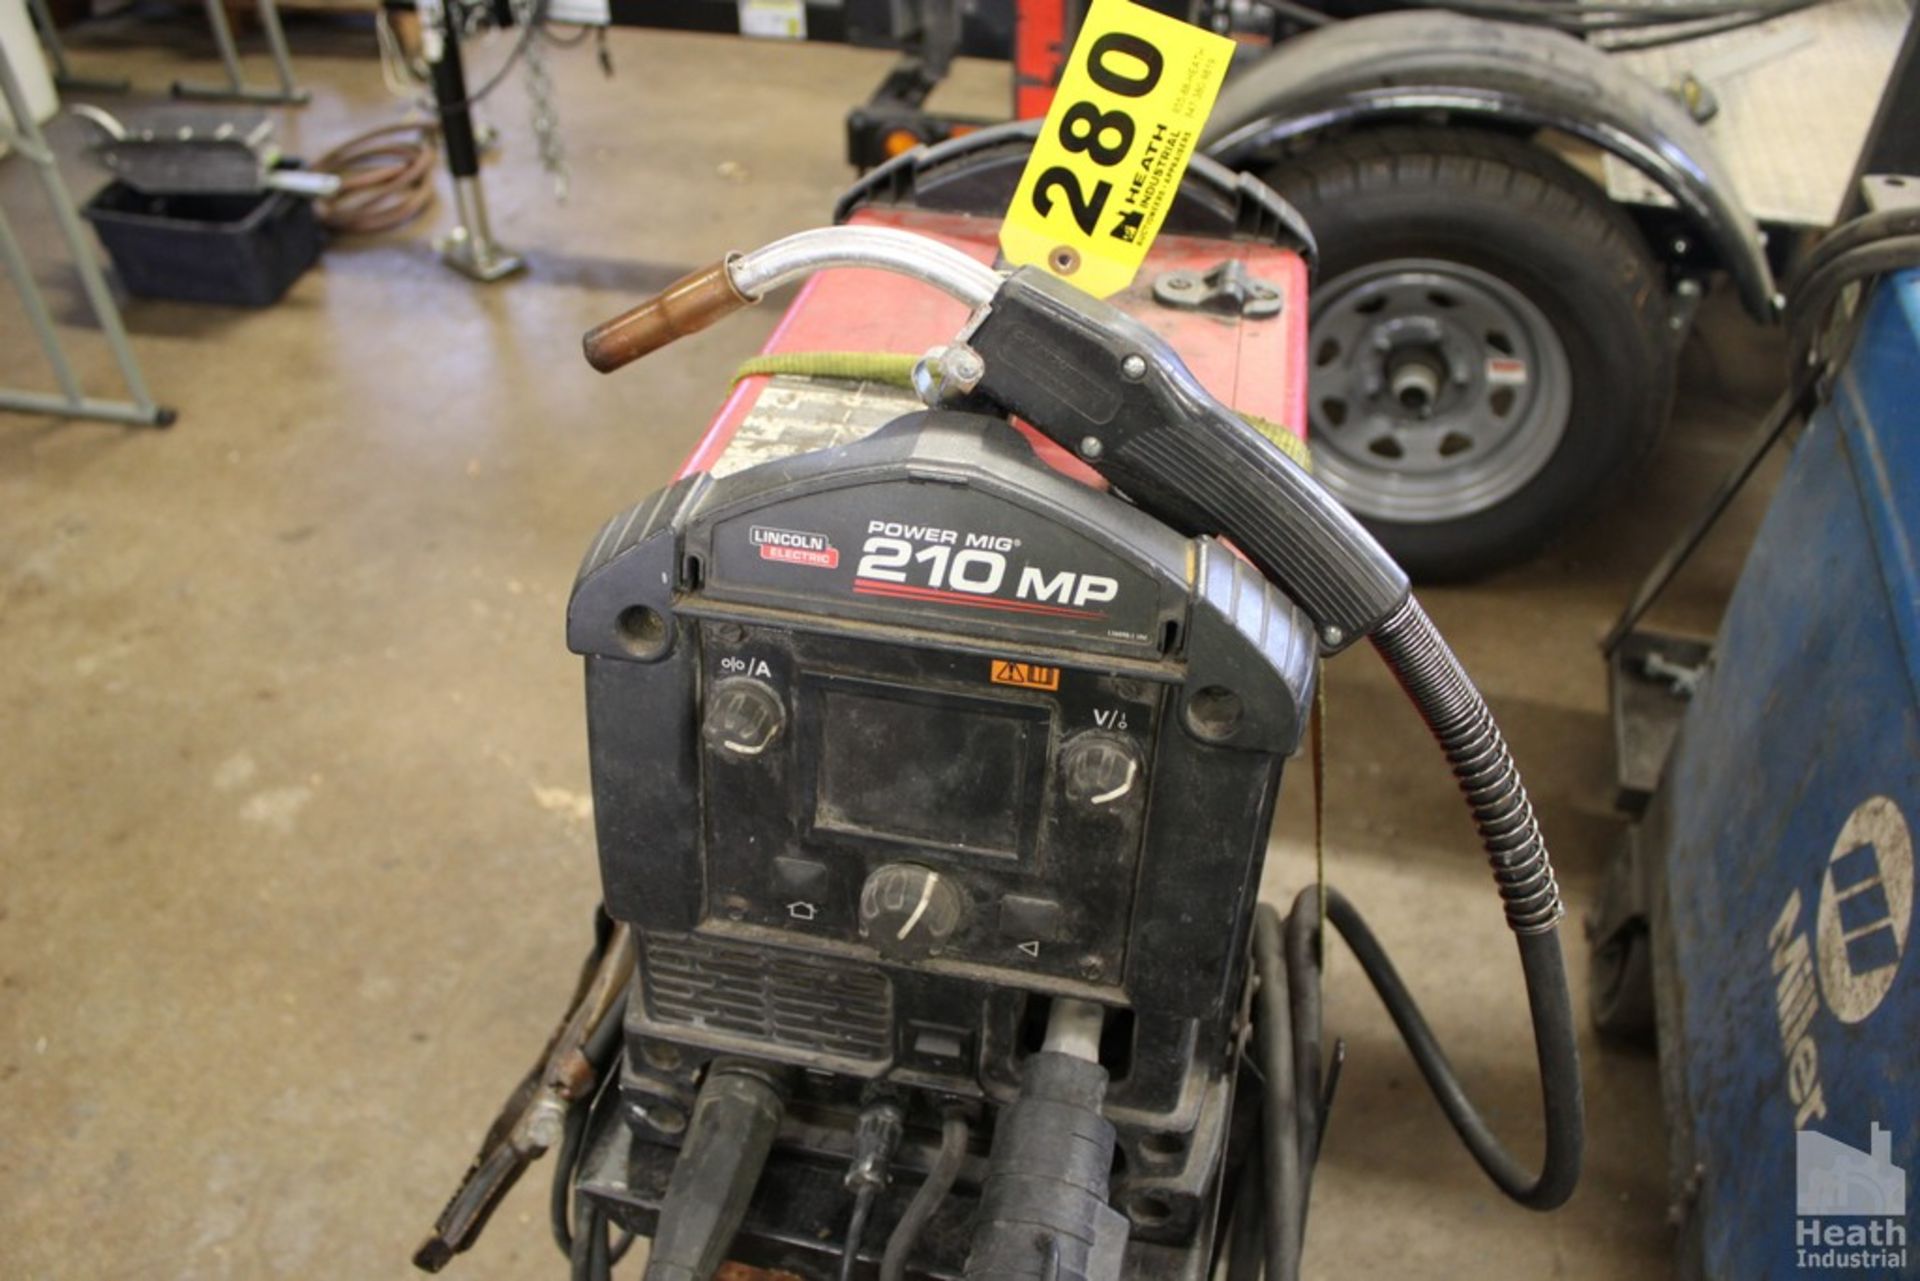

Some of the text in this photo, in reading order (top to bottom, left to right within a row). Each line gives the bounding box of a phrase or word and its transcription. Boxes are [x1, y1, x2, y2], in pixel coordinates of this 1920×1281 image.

[1032, 32, 1164, 237] 280
[1125, 123, 1167, 204] HEATH
[1139, 130, 1181, 209] INDUSTRIAL
[1164, 131, 1192, 185] APPRAISERS
[754, 529, 824, 551] LINCOLN
[769, 547, 830, 565] ELECTRIC
[867, 520, 958, 545] POWER
[856, 536, 1119, 607] 210 MP
[1767, 885, 1828, 1132] Miller
